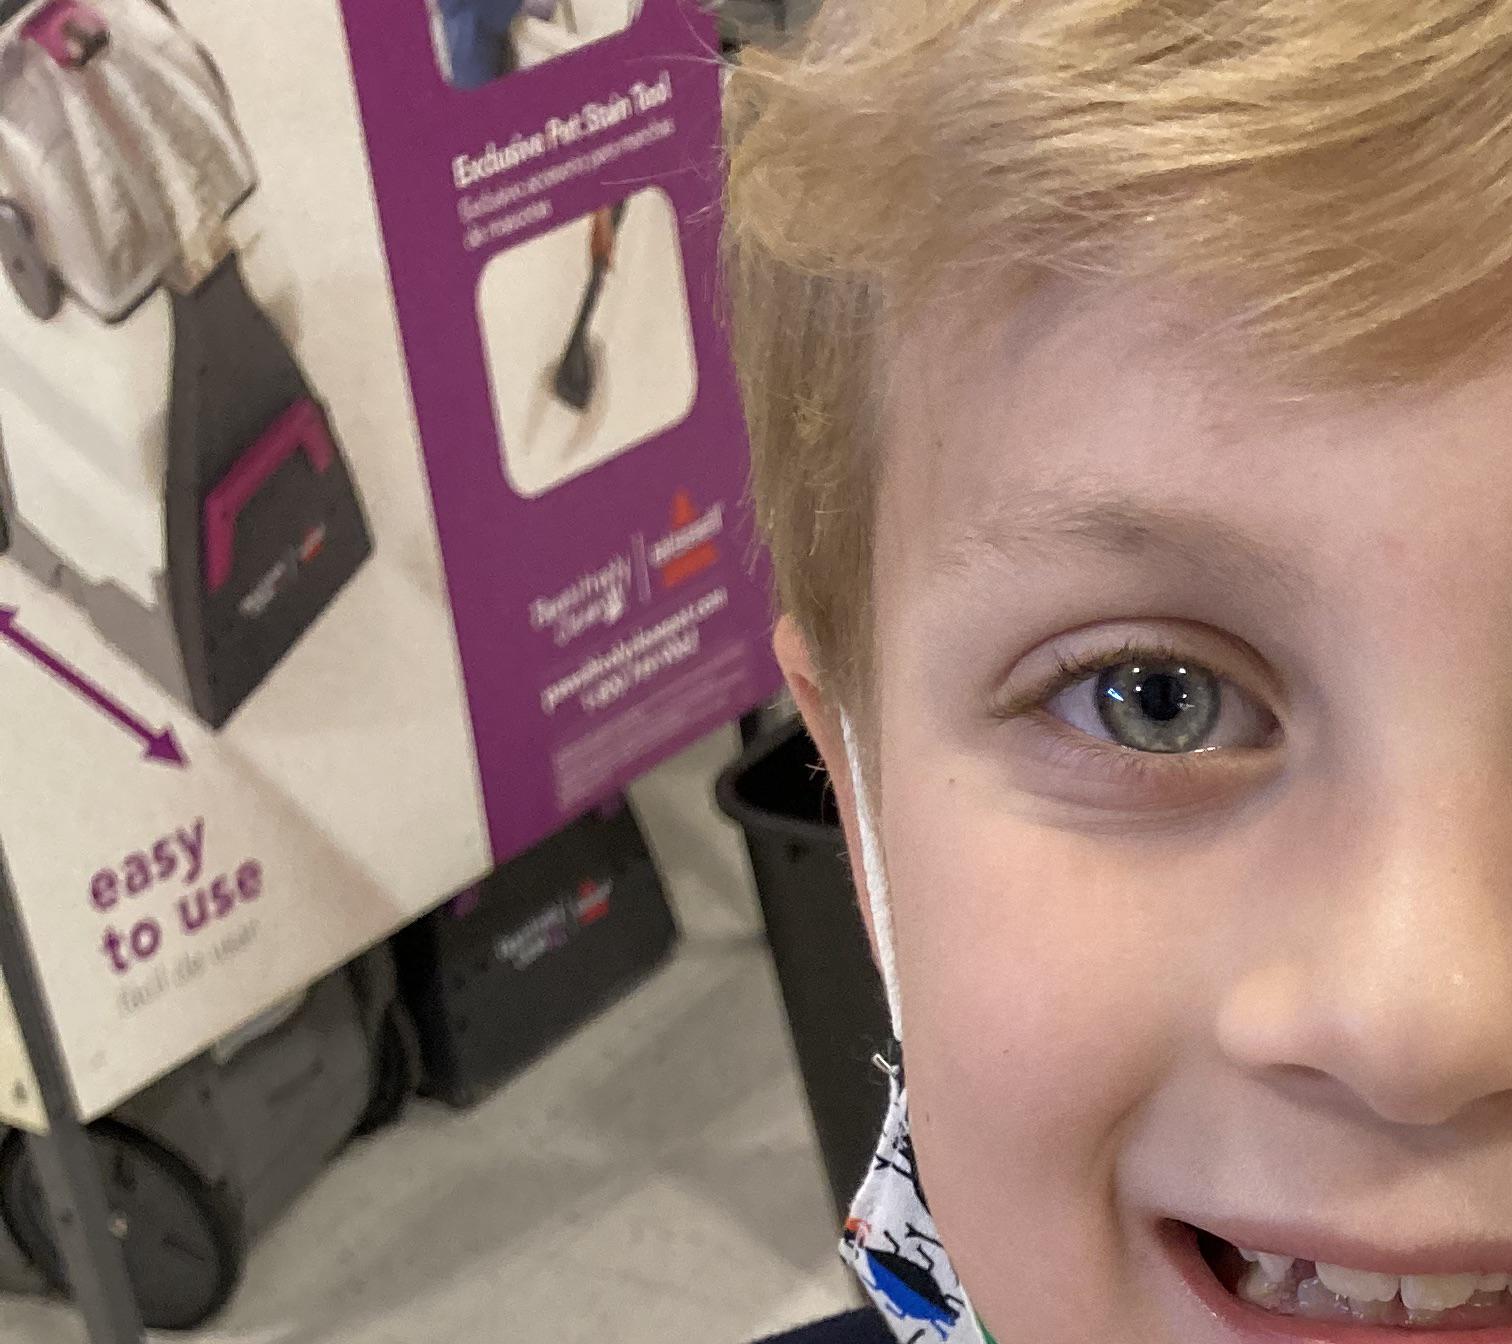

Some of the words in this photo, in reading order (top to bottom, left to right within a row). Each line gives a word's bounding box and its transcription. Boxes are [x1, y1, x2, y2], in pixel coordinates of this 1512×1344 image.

[89, 815, 205, 913] easy
[101, 917, 163, 974] to
[176, 856, 264, 935] use
